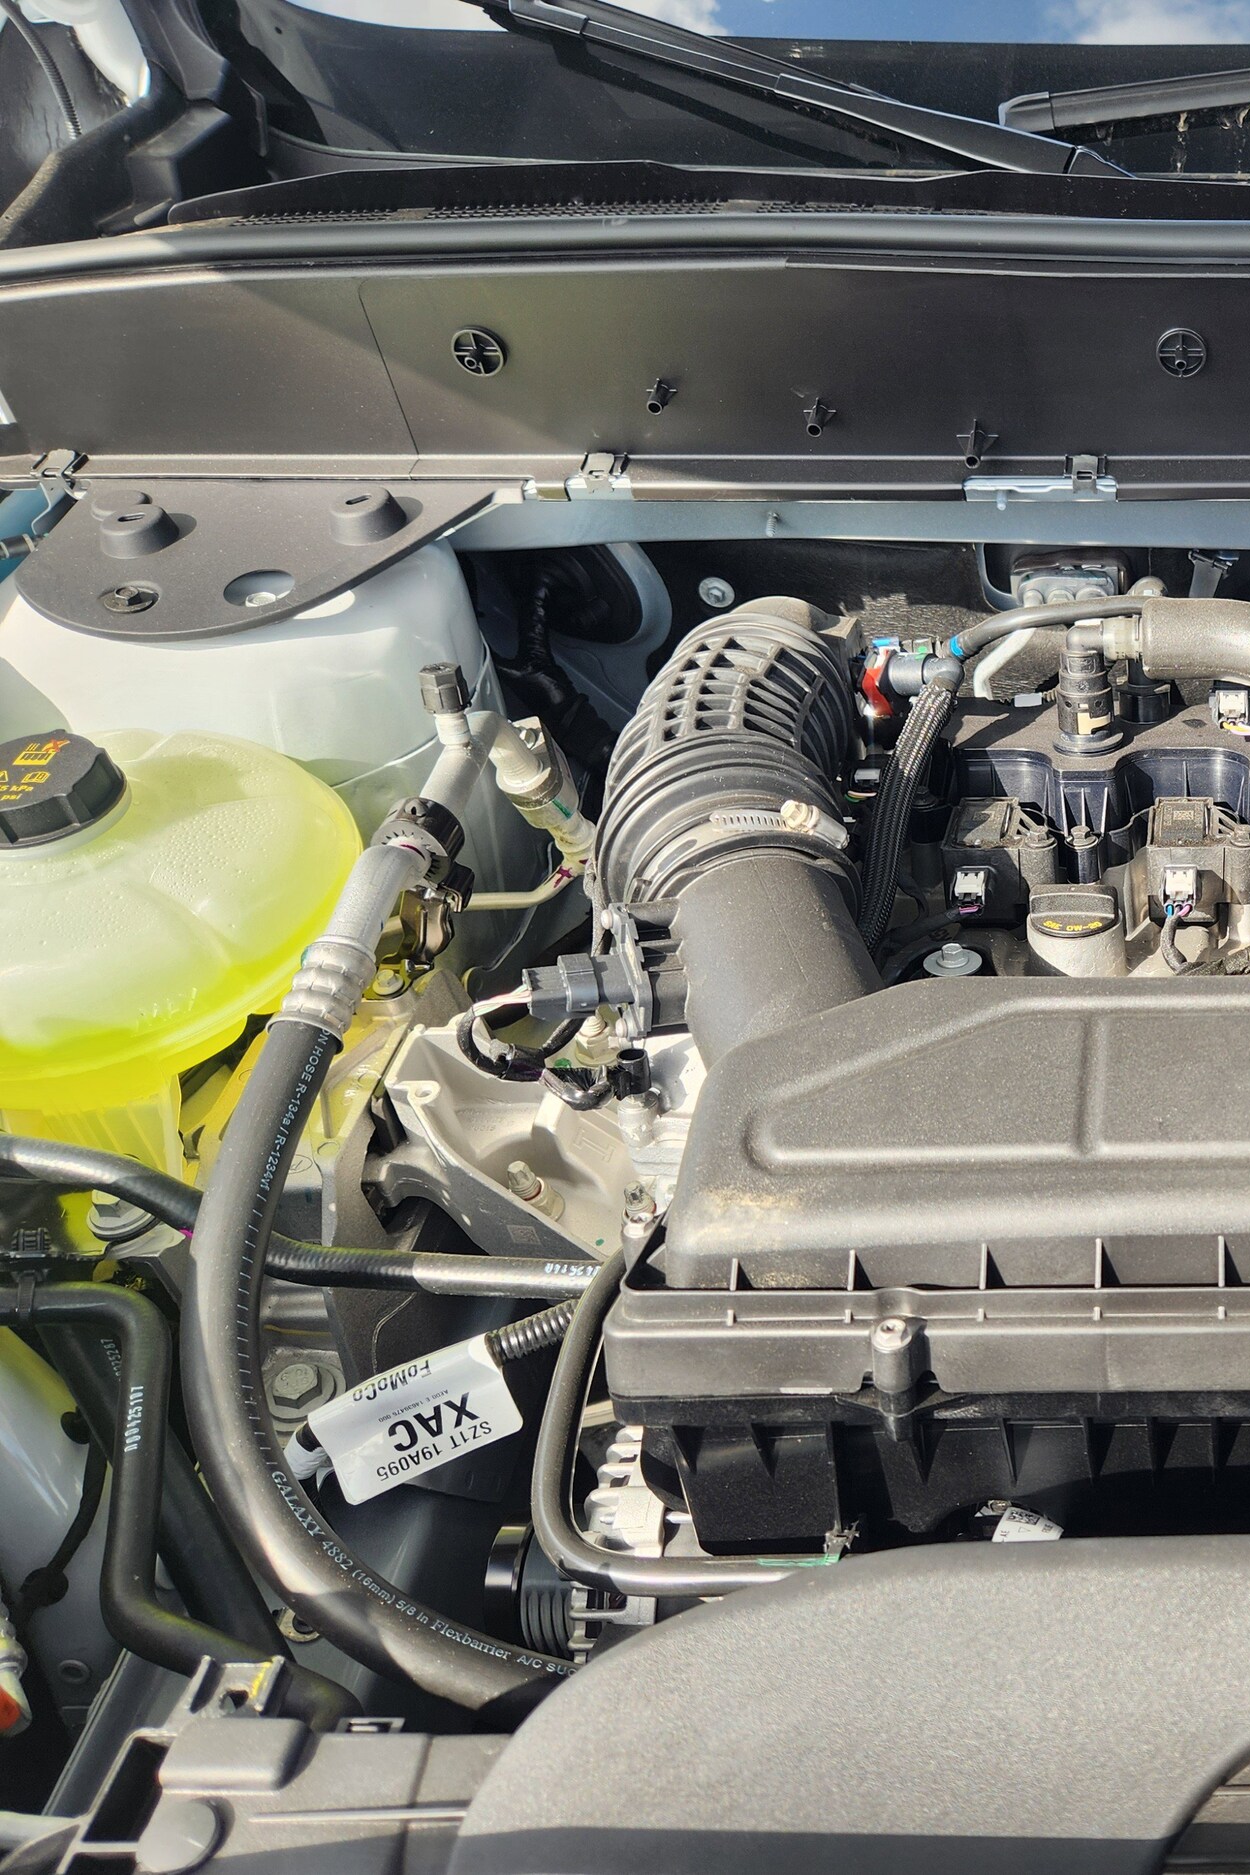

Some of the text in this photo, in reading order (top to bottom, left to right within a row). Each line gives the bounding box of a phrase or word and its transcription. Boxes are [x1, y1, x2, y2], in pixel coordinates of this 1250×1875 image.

[301, 1045, 324, 1082] HOSE
[282, 1082, 308, 1126] R-134a
[352, 1358, 432, 1404] FoMoCo
[387, 1391, 480, 1452] XAC
[375, 1421, 492, 1482] SZ1T 19A095
[271, 1471, 326, 1538] GALAXY
[321, 1539, 354, 1571] 4882
[351, 1568, 395, 1605] (16mm)
[395, 1598, 416, 1618] 5/8
[430, 1620, 511, 1660] Flexbarrier
[516, 1653, 543, 1670] A/C
